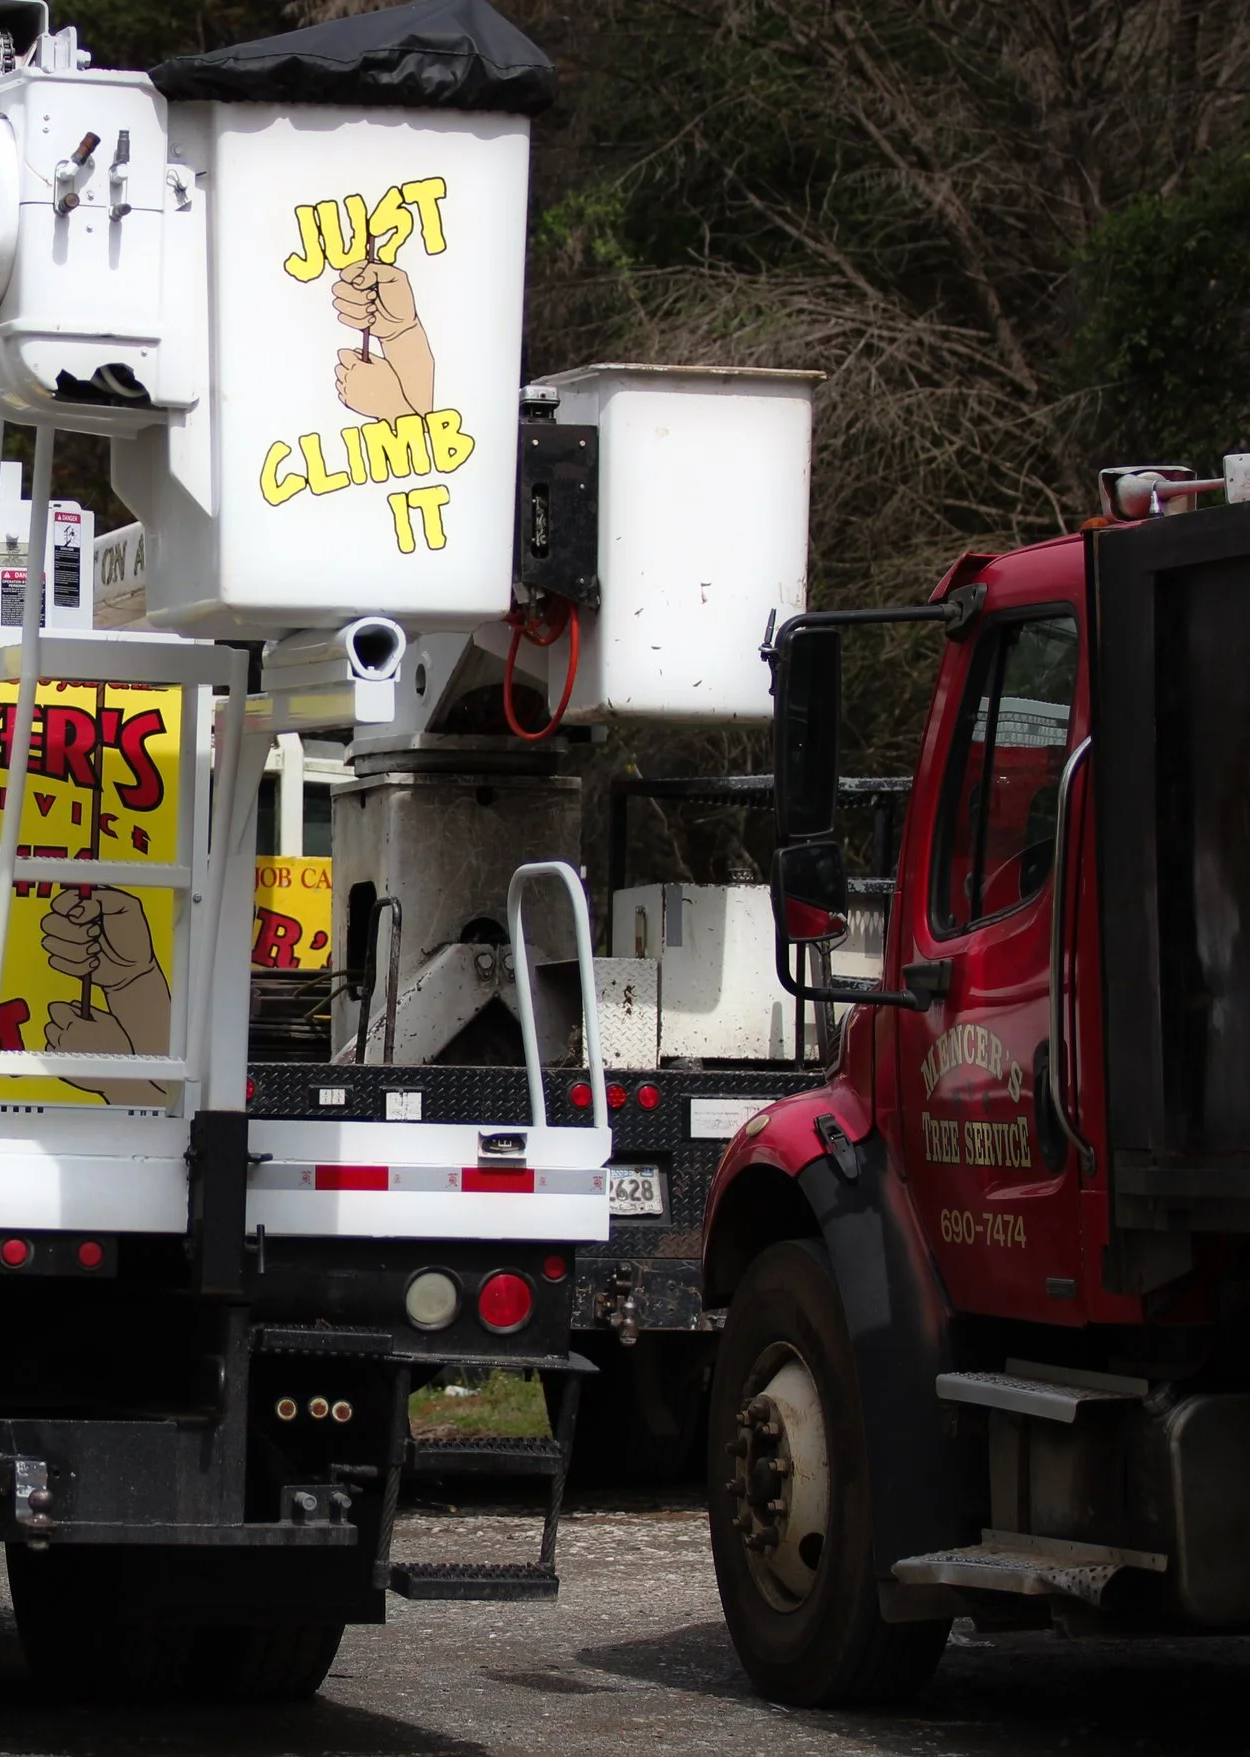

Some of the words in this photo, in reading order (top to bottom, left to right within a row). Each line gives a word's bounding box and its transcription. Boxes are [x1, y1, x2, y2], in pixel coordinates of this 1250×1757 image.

[283, 176, 447, 283] JUST
[259, 408, 475, 506] CLIMB
[387, 484, 451, 554] IT
[300, 867, 333, 890] CA
[920, 1023, 1024, 1104] MENCER'S
[921, 1111, 961, 1164] TREE
[964, 1115, 1032, 1168] SERVICE
[940, 1208, 1027, 1249] 690-7474
